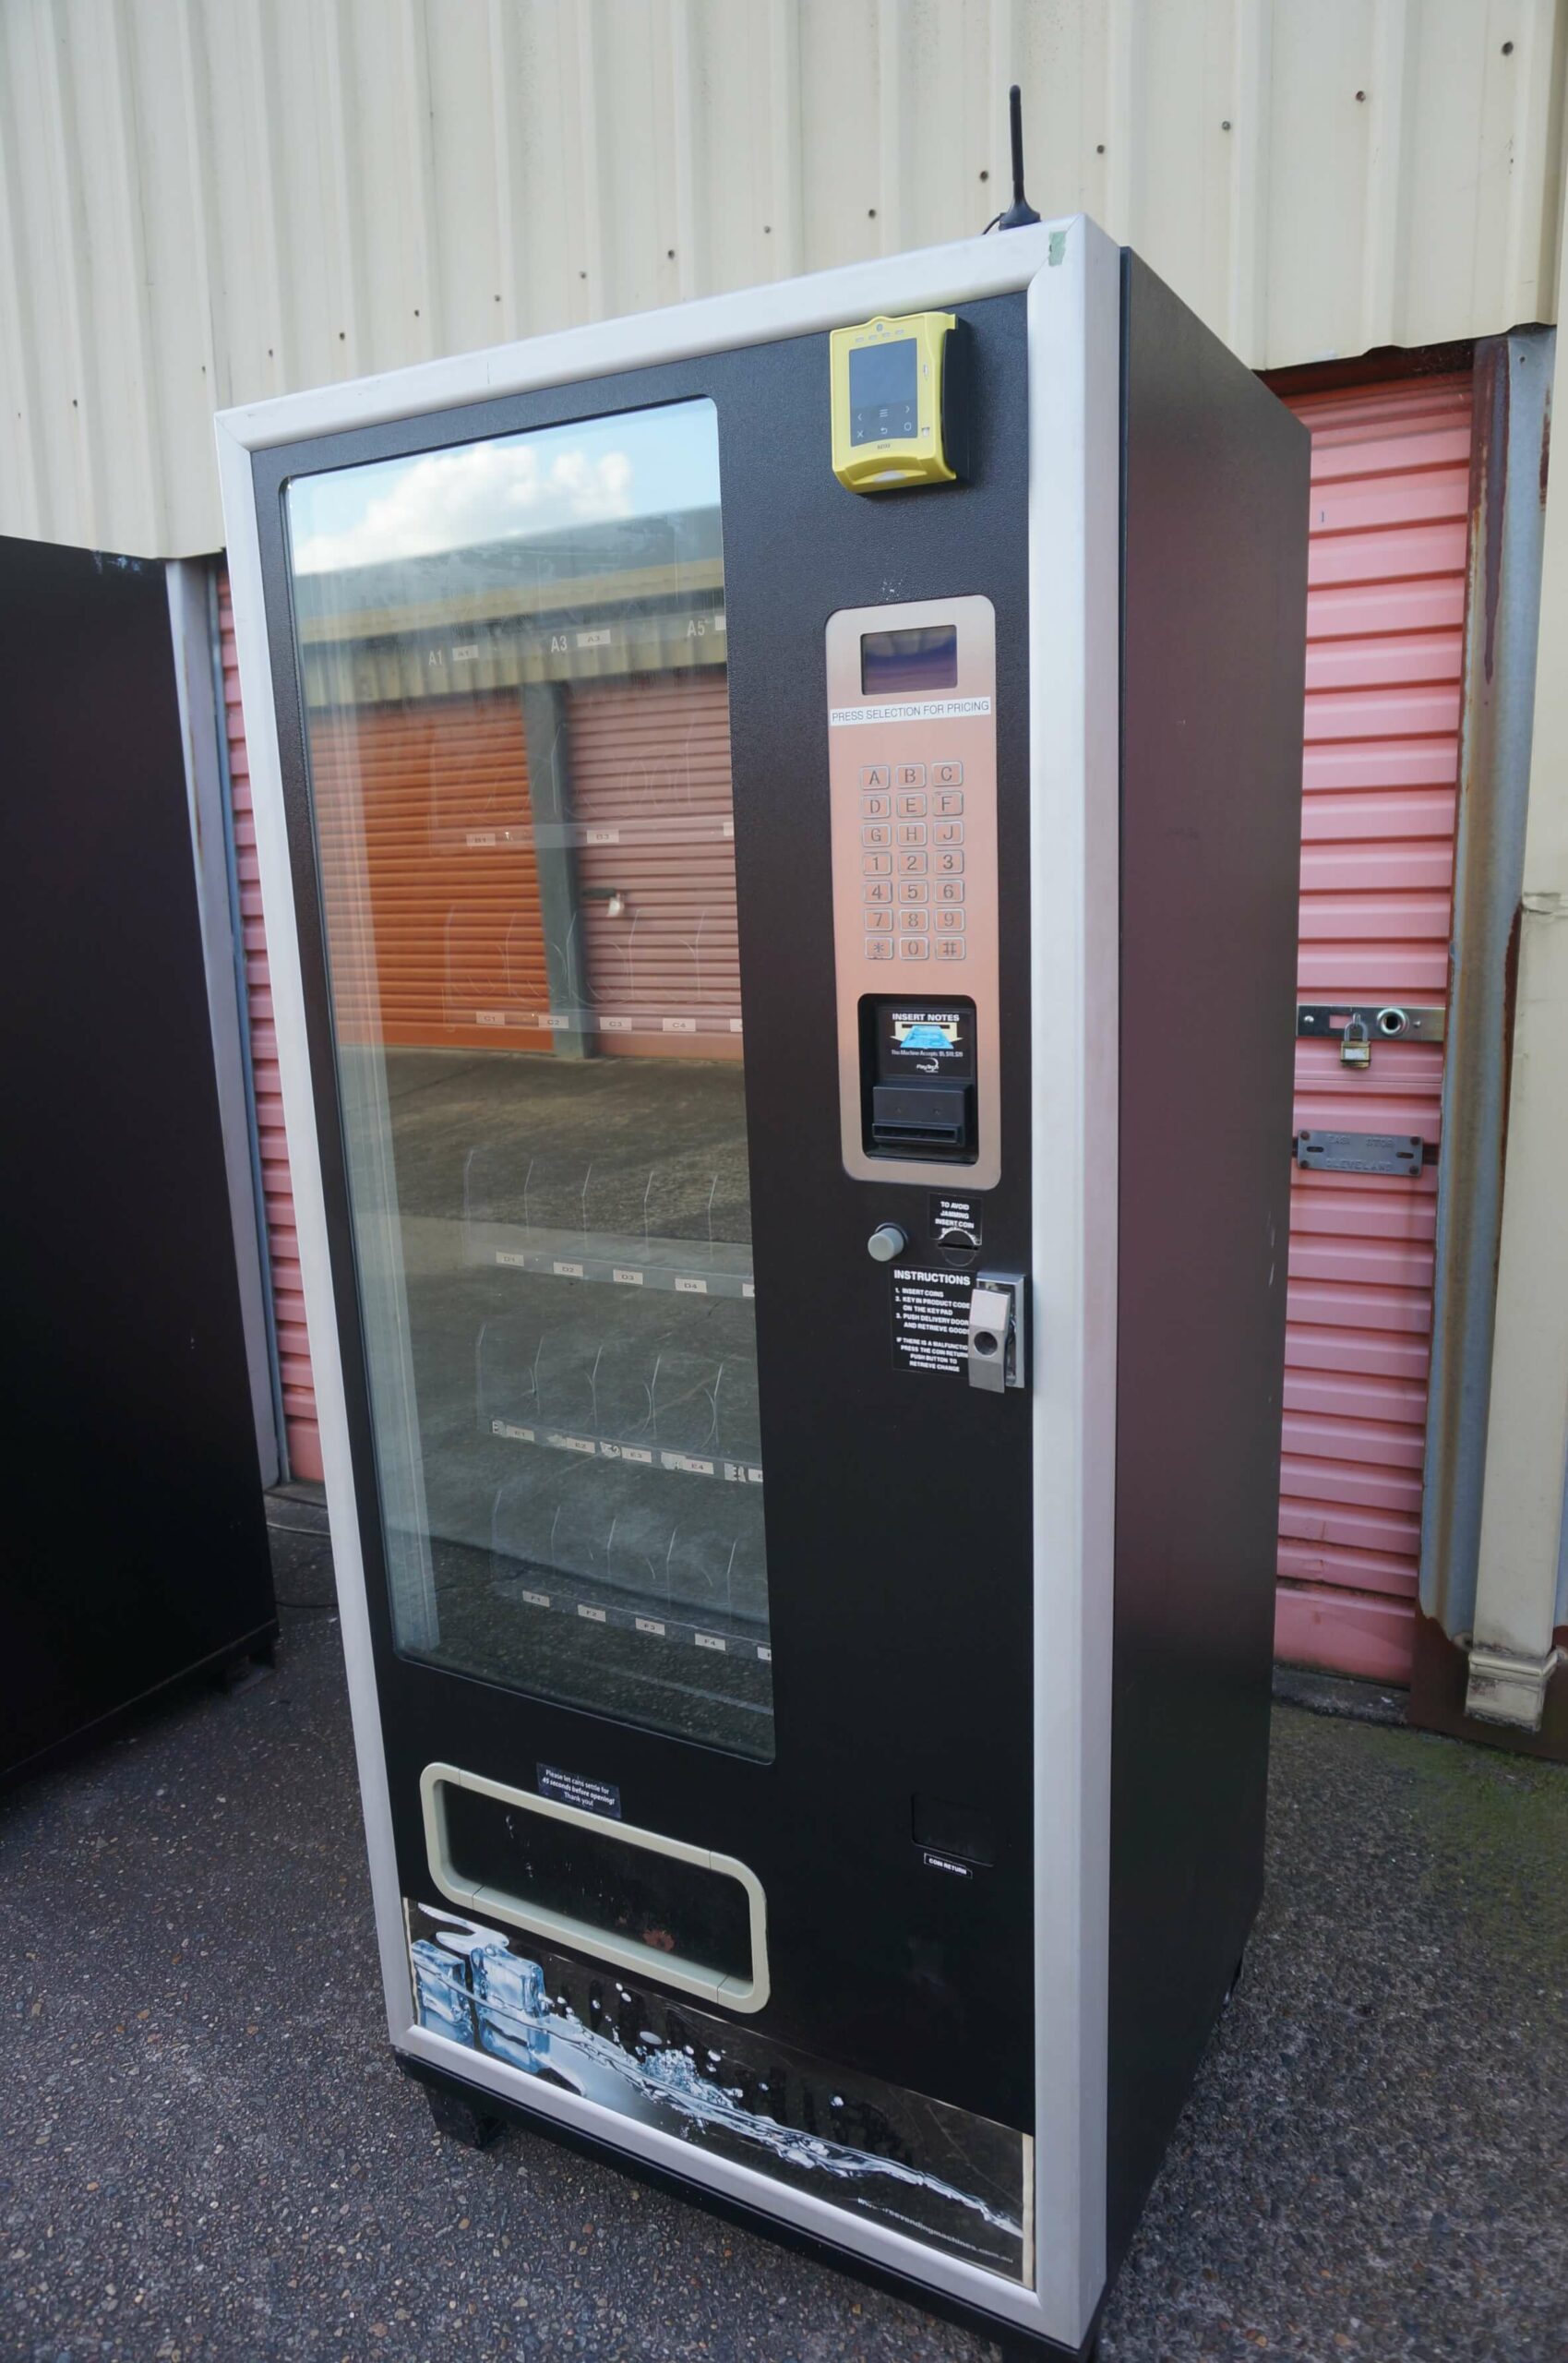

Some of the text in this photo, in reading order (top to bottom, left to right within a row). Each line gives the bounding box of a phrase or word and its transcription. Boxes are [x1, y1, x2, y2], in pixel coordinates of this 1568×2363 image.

[687, 620, 705, 637] A5
[551, 635, 567, 653] A3
[428, 650, 442, 665] A1
[832, 701, 989, 722] PRESS SELECTION FOR PRICING
[869, 767, 952, 785] A B C
[870, 796, 952, 813] D E F
[871, 825, 953, 842] G H J
[873, 854, 953, 870] 1 2 3
[871, 884, 953, 900] 4 5 6
[873, 912, 954, 927] 7 8 9
[908, 942, 918, 954] 0
[928, 1014, 960, 1022] NOTES
[951, 1202, 969, 1210] AVOID
[940, 1210, 969, 1219] JAMMING
[958, 1220, 975, 1229] COIN
[893, 1269, 971, 1285] INSTRUCTIONS
[923, 1298, 952, 1307] PRODUCT
[921, 1315, 951, 1324] DELIVERY
[917, 1323, 948, 1332] RETRIEVE
[933, 1341, 968, 1350] MALFUNCTIO
[946, 1349, 968, 1358] RETURN
[909, 1361, 960, 1373] RETRIEVE CHANGE
[545, 1769, 563, 1780] Please
[572, 1779, 584, 1787] cans
[585, 1782, 600, 1792] settle
[542, 1776, 615, 1805] 45 seconds before opening!
[564, 1792, 581, 1803] Thank
[928, 1857, 966, 1875] COIN RETURN
[858, 2197, 1013, 2263] wwreevendingmachines.com.au
